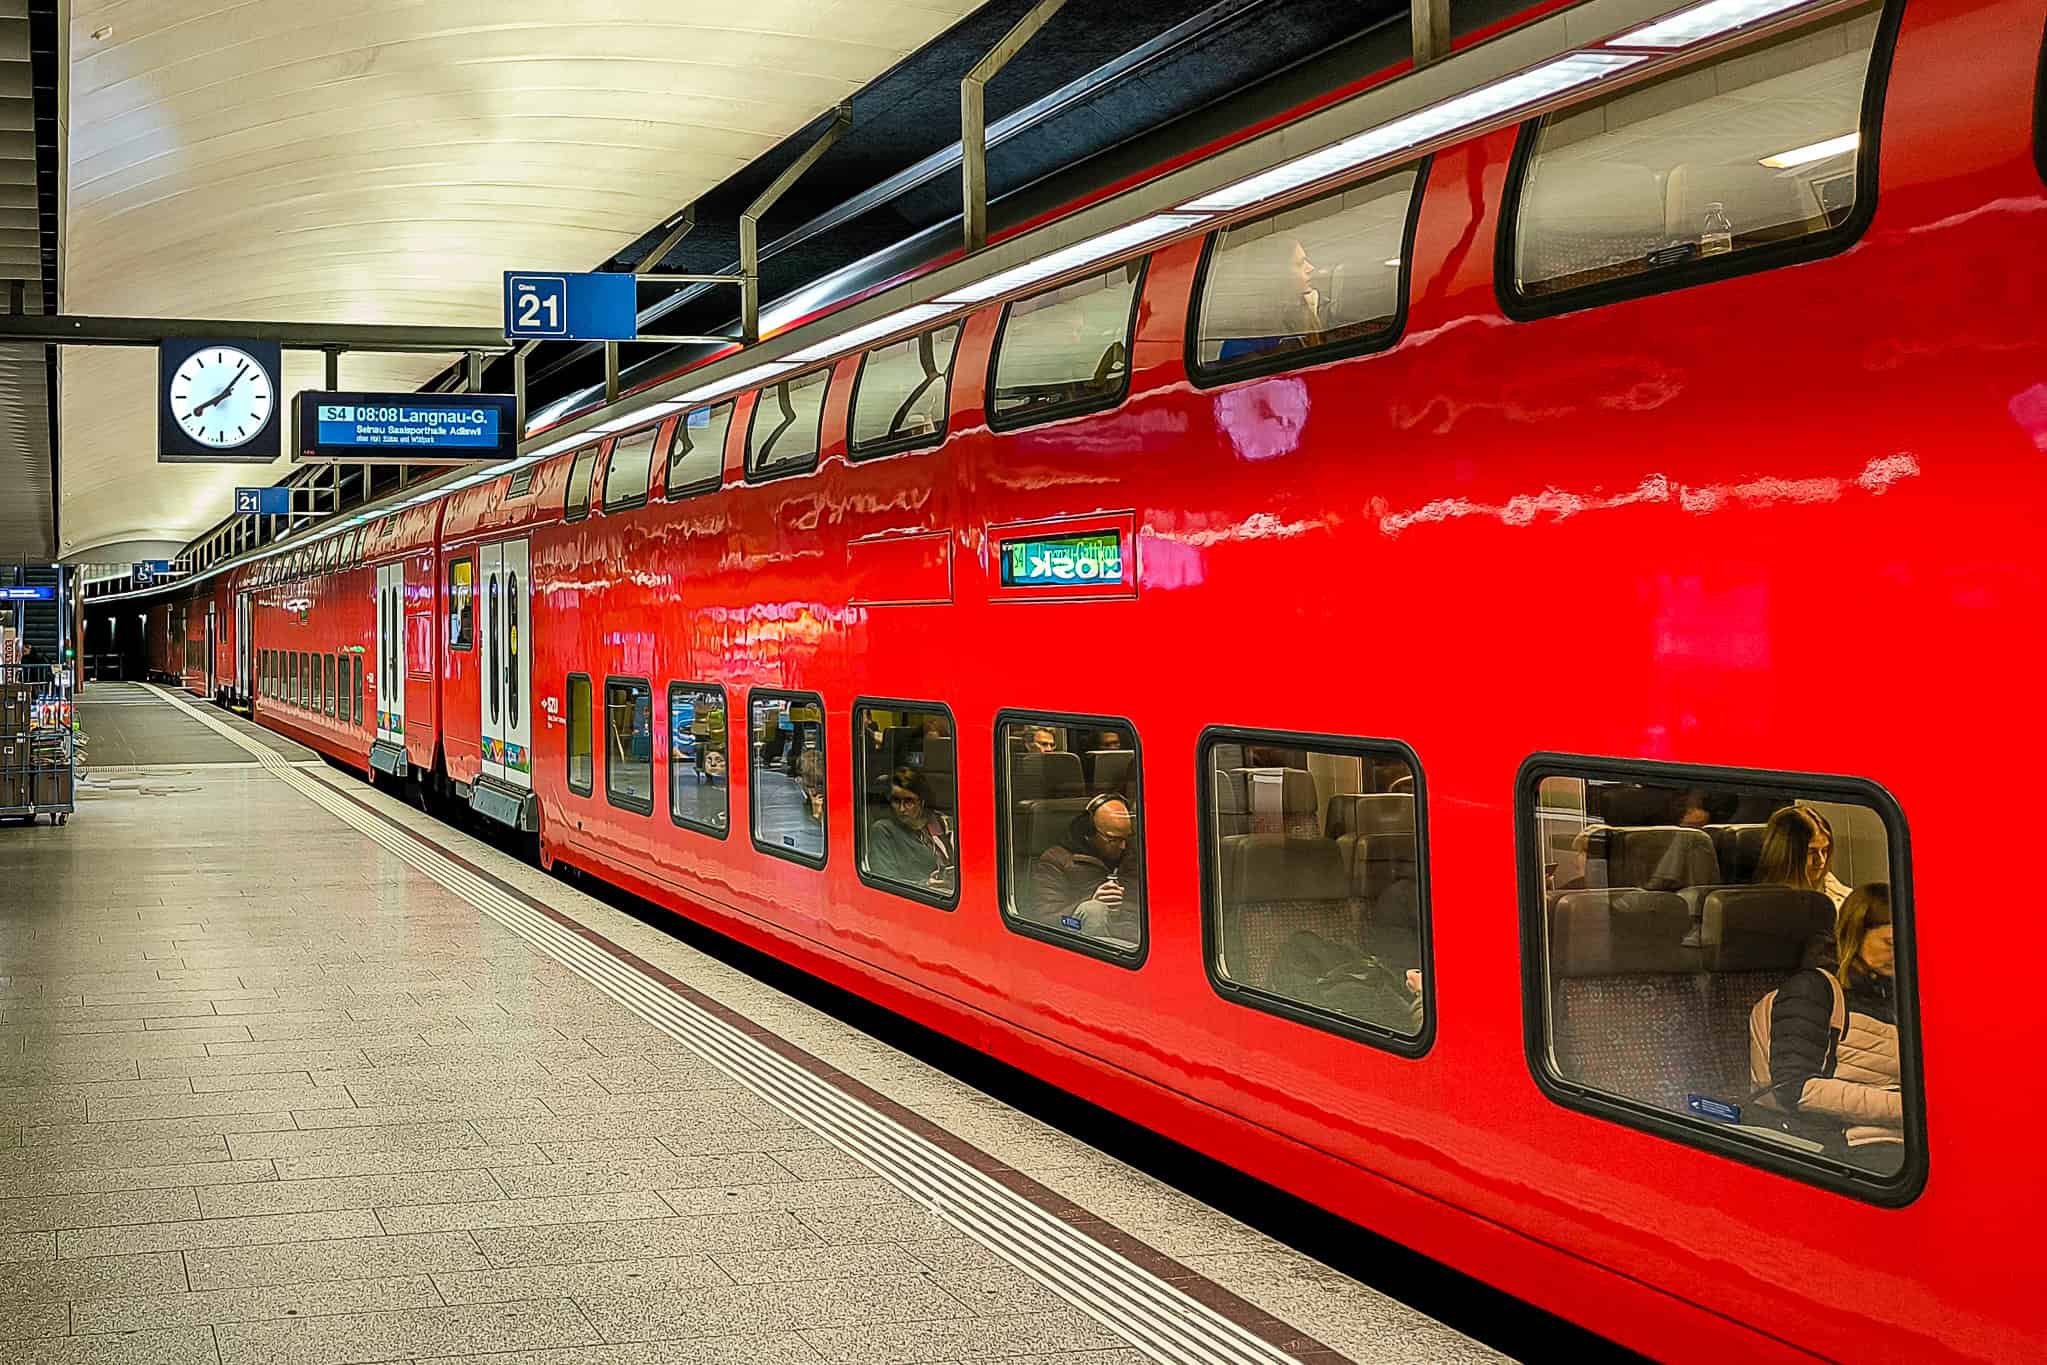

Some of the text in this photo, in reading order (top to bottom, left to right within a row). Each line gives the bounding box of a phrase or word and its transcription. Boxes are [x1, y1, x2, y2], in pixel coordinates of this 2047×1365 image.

[518, 293, 558, 327] 21
[327, 407, 487, 426] S4 08:08 Langnau-G.
[240, 495, 257, 510] 21
